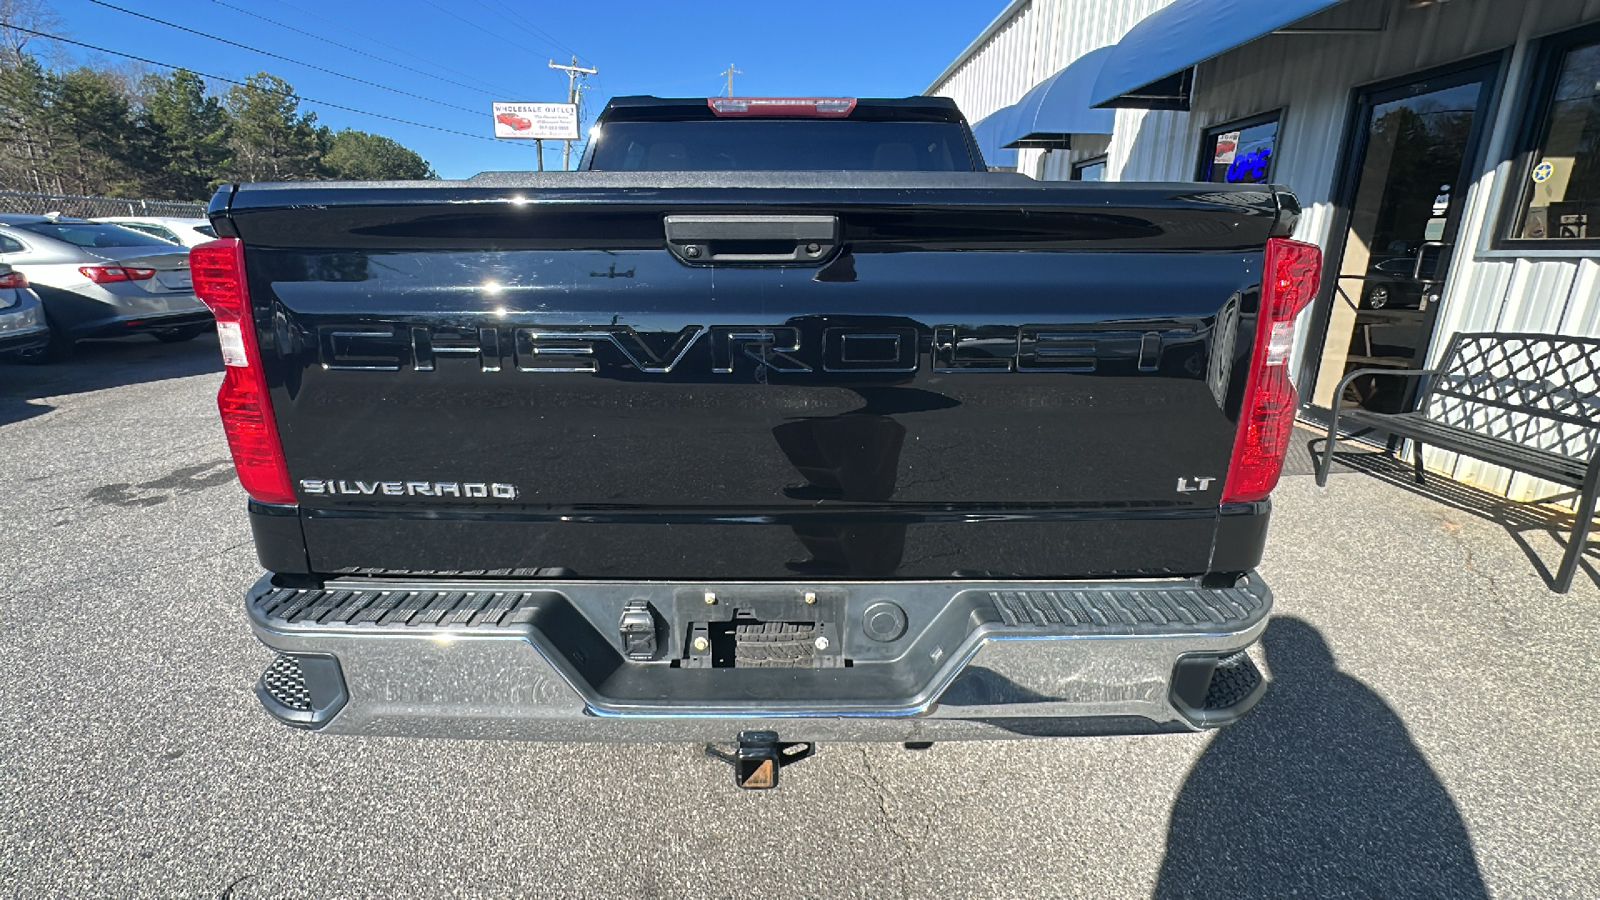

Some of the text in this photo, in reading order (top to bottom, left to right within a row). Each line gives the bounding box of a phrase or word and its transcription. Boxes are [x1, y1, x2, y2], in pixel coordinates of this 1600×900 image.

[1226, 148, 1271, 182] OPE
[318, 324, 1198, 374] CHEVROLET
[300, 479, 519, 500] SILVERADO
[1177, 476, 1216, 492] LT
